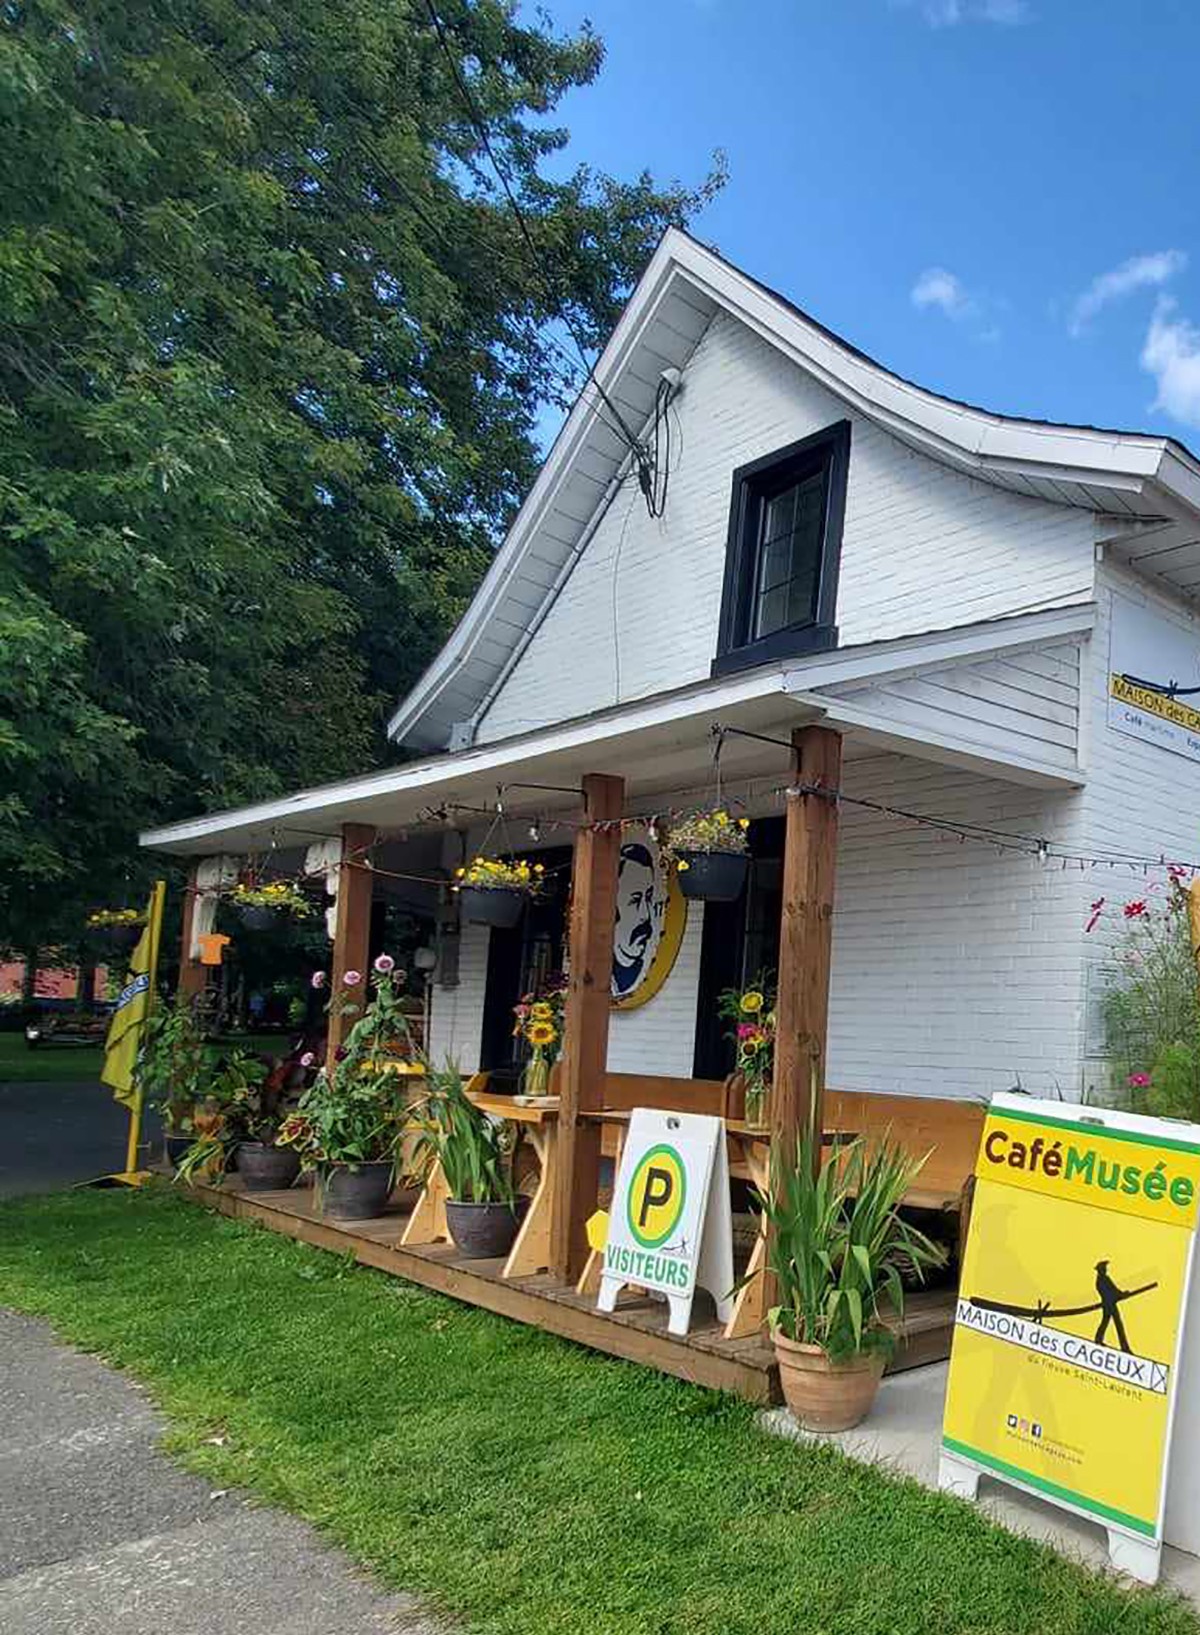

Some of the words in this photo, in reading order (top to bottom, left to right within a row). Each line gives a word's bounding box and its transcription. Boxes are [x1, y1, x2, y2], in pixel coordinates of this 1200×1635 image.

[1112, 680, 1163, 713] MAISON
[1166, 705, 1185, 723] des
[639, 1166, 673, 1227] P
[606, 1244, 689, 1288] VISITEURS
[957, 1303, 1026, 1341] MAISON
[1029, 1329, 1058, 1352] des
[1063, 1340, 1146, 1381] CAGEUX
[1073, 1369, 1143, 1401] Saint-Laurent
